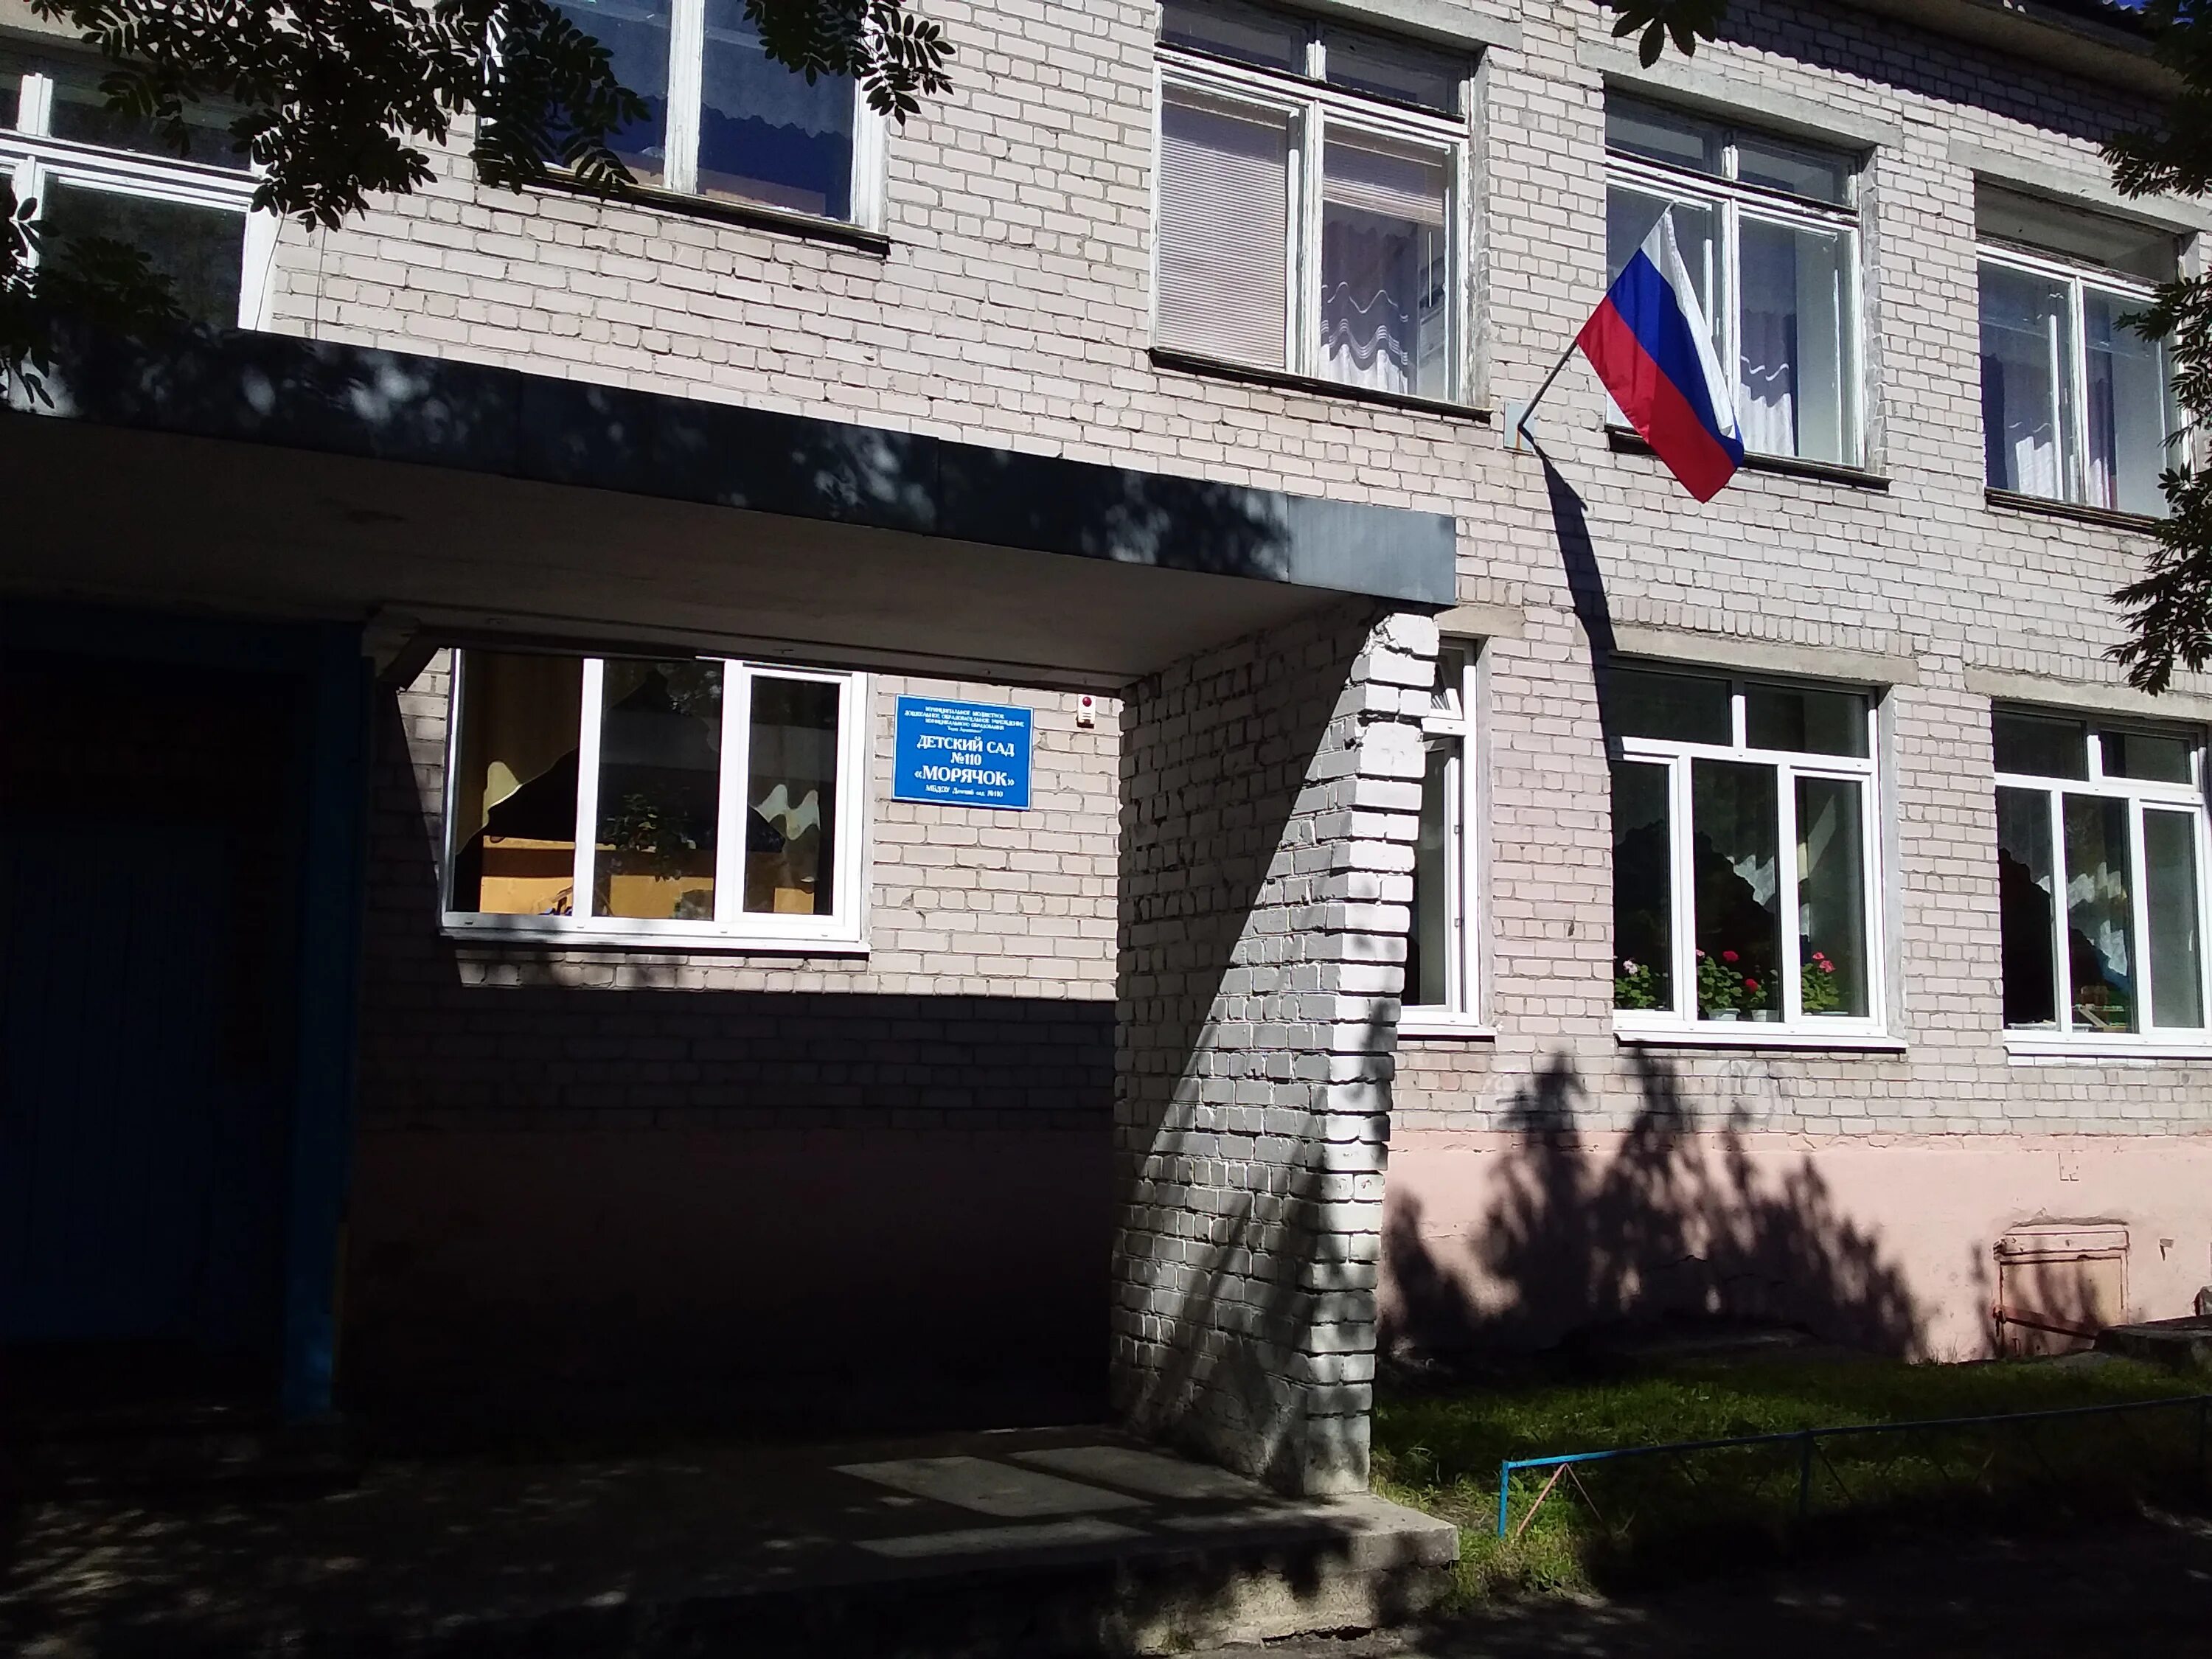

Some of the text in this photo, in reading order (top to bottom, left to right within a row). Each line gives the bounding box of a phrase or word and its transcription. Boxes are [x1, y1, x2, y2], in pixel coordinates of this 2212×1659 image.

[917, 734, 1015, 757] ДЕТСКИЙ САД
[950, 751, 982, 765] №110
[914, 765, 1015, 787] «МОРЯЧОК»
